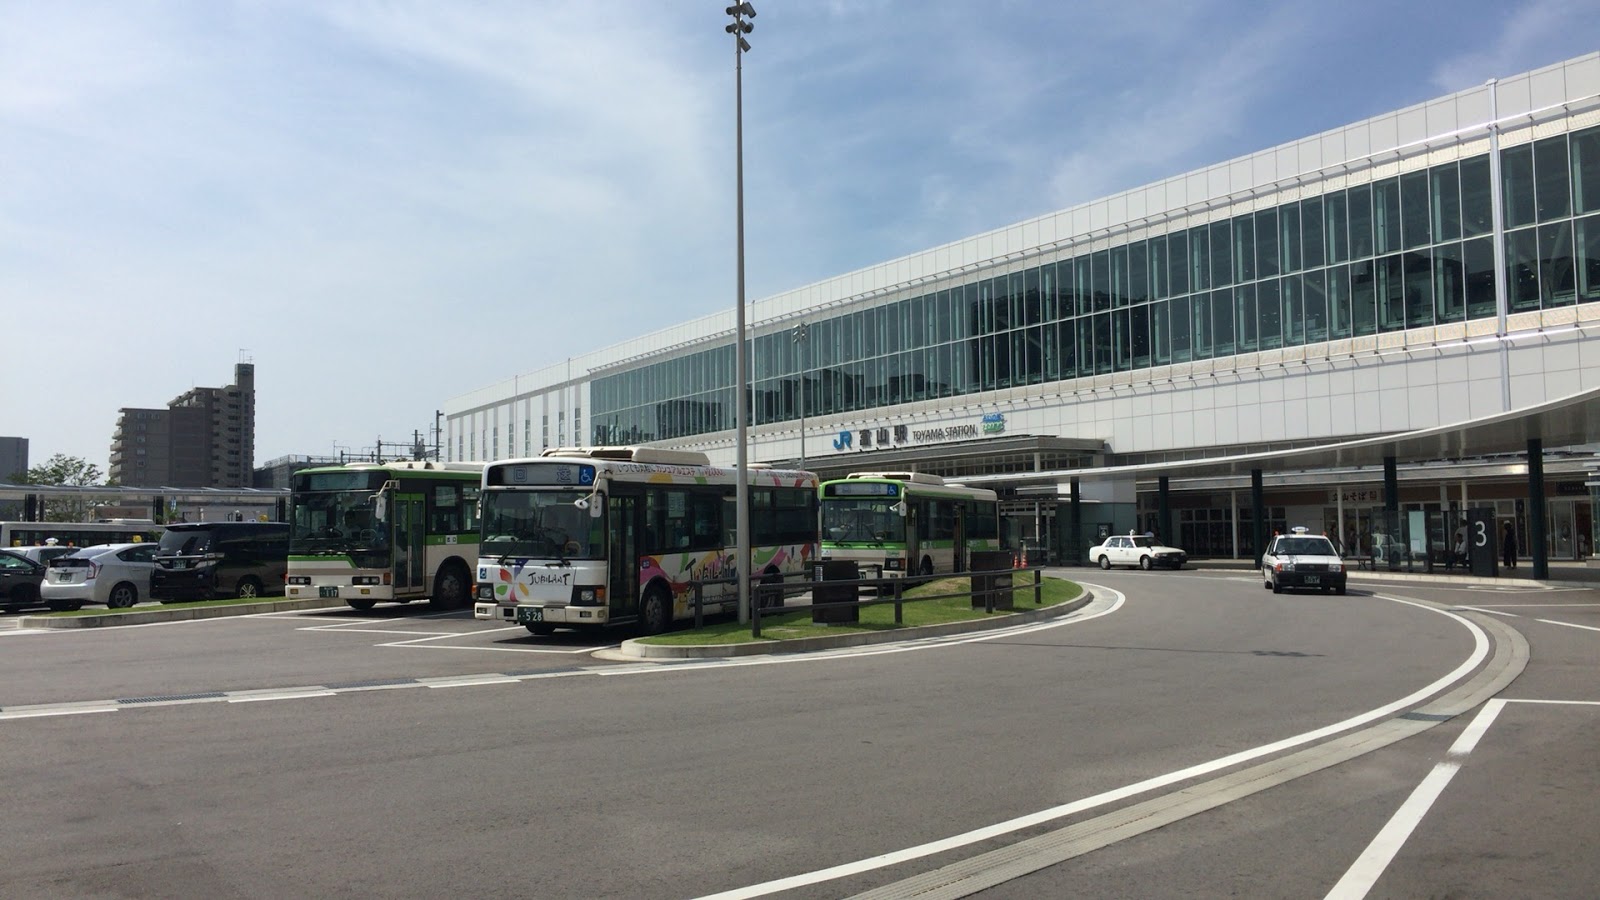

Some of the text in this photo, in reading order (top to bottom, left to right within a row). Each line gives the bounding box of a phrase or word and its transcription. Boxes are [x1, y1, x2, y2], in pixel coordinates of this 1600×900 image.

[833, 424, 976, 450] JR 富山駅 TOYAMA STATION
[1475, 521, 1487, 547] 3
[528, 572, 571, 586] JUBILANT
